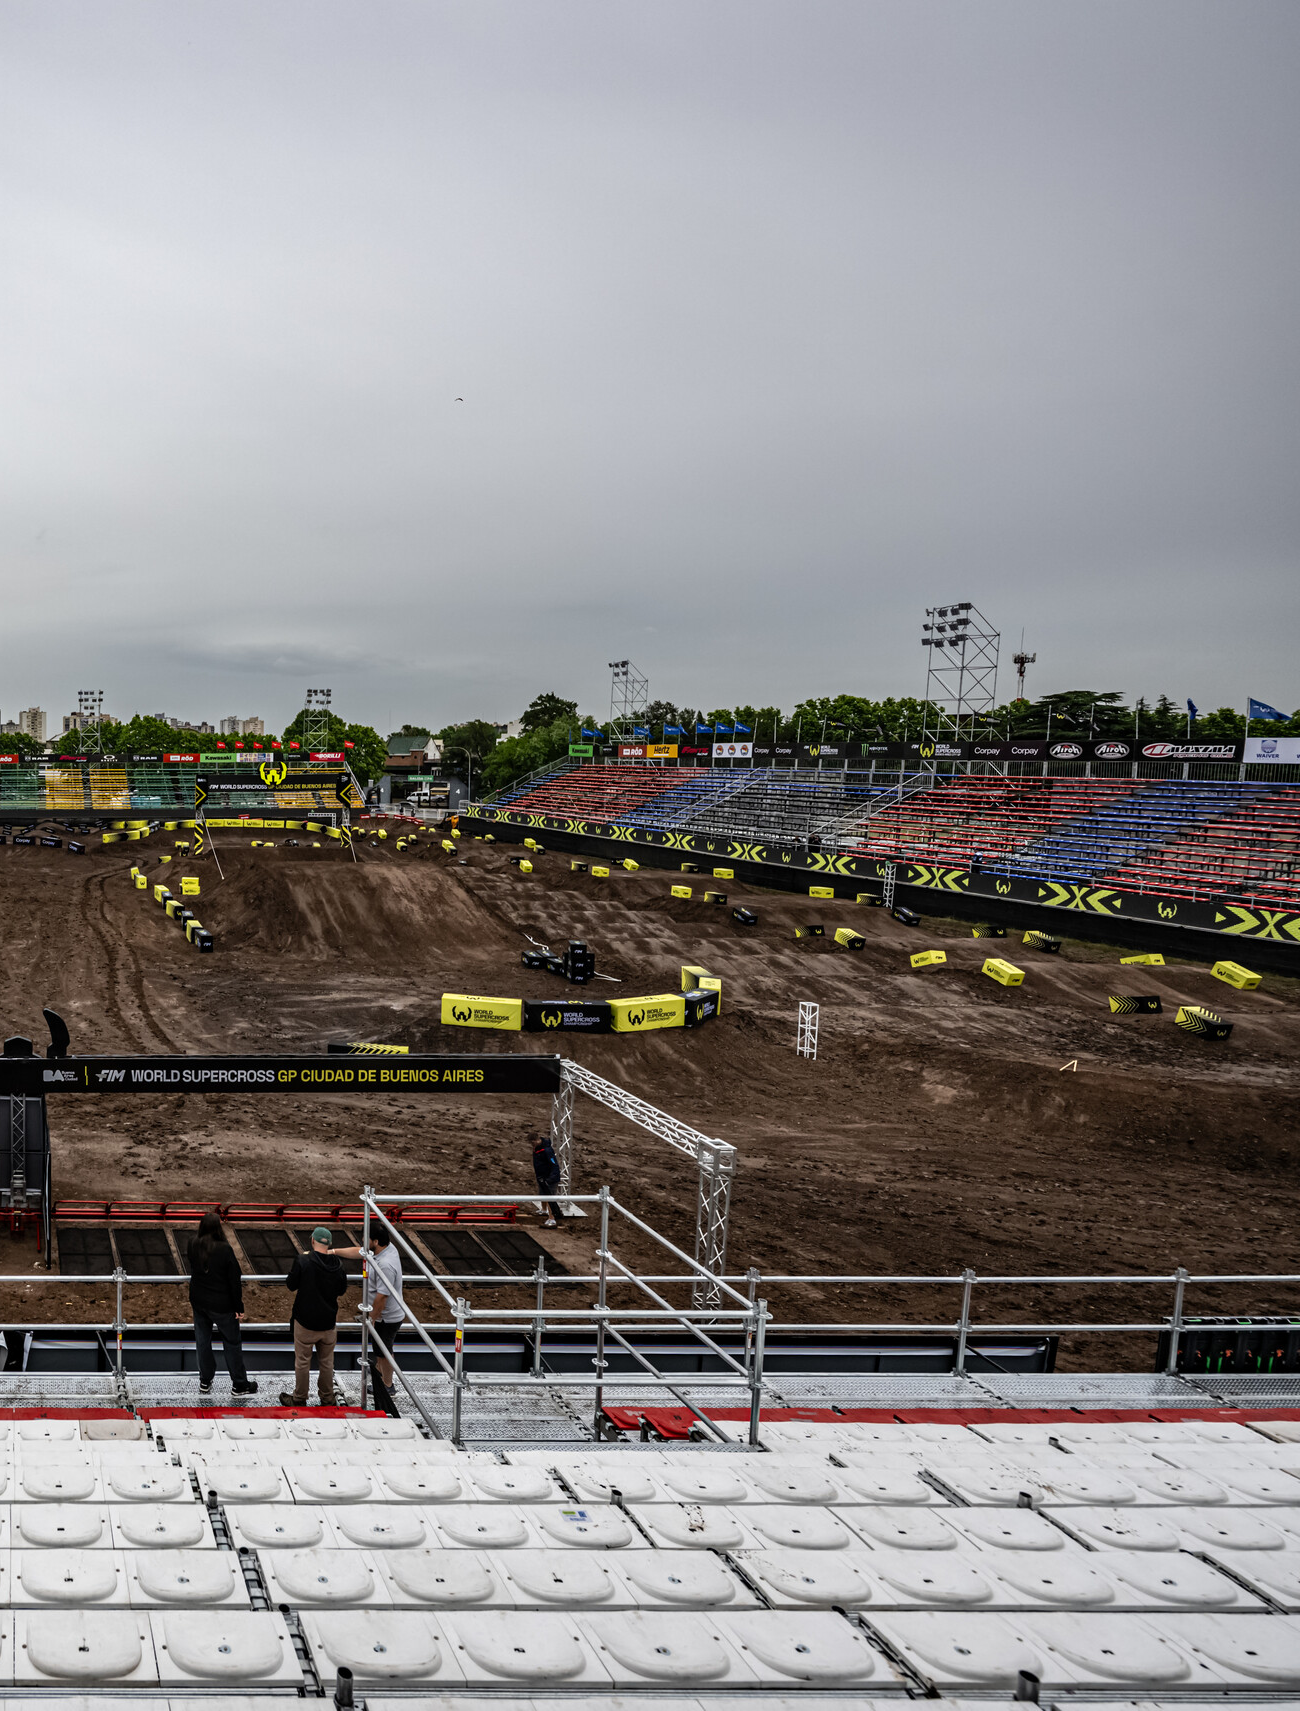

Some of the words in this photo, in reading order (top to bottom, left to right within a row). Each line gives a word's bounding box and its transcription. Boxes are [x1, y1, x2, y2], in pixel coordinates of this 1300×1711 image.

[653, 745, 670, 754] Hertz
[974, 747, 1001, 756] Corpay
[1011, 746, 1039, 756] Corpay
[1052, 745, 1080, 754] Airoh
[1097, 745, 1127, 754] Airoh
[474, 1013, 509, 1022] SUPERCROSS
[646, 1011, 676, 1020] SUPERCROSS
[42, 1069, 64, 1082] BA
[95, 1068, 126, 1082] FIM
[131, 1069, 180, 1082] WORLD
[182, 1069, 275, 1082] SUPERCROSS
[277, 1069, 297, 1082] GP
[300, 1069, 354, 1082] CIUDAD
[357, 1069, 377, 1082] DE
[380, 1069, 439, 1082] BUENOS
[442, 1068, 484, 1082] AIRES
